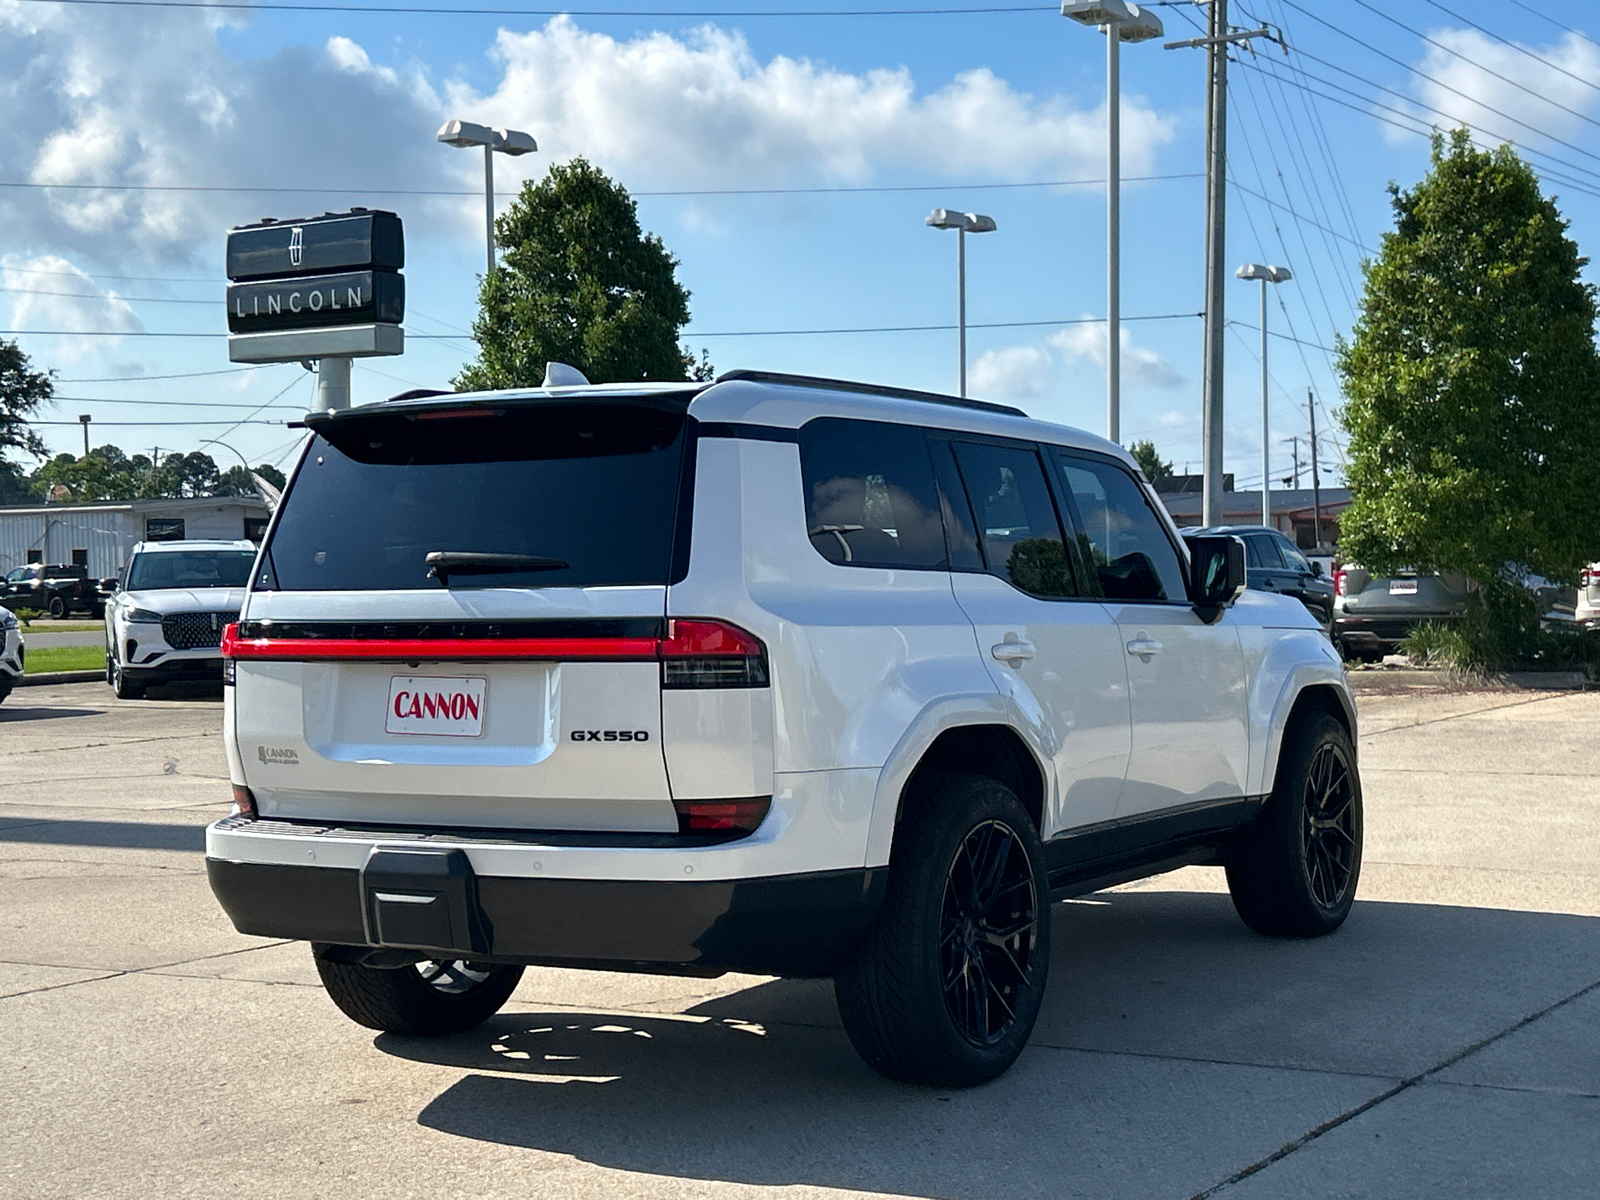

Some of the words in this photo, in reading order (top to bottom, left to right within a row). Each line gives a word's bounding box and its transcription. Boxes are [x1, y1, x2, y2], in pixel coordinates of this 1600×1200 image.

[236, 286, 362, 317] LINCOLN
[394, 691, 480, 721] CANNON
[571, 731, 649, 742] GX550
[265, 747, 299, 759] CANNON
